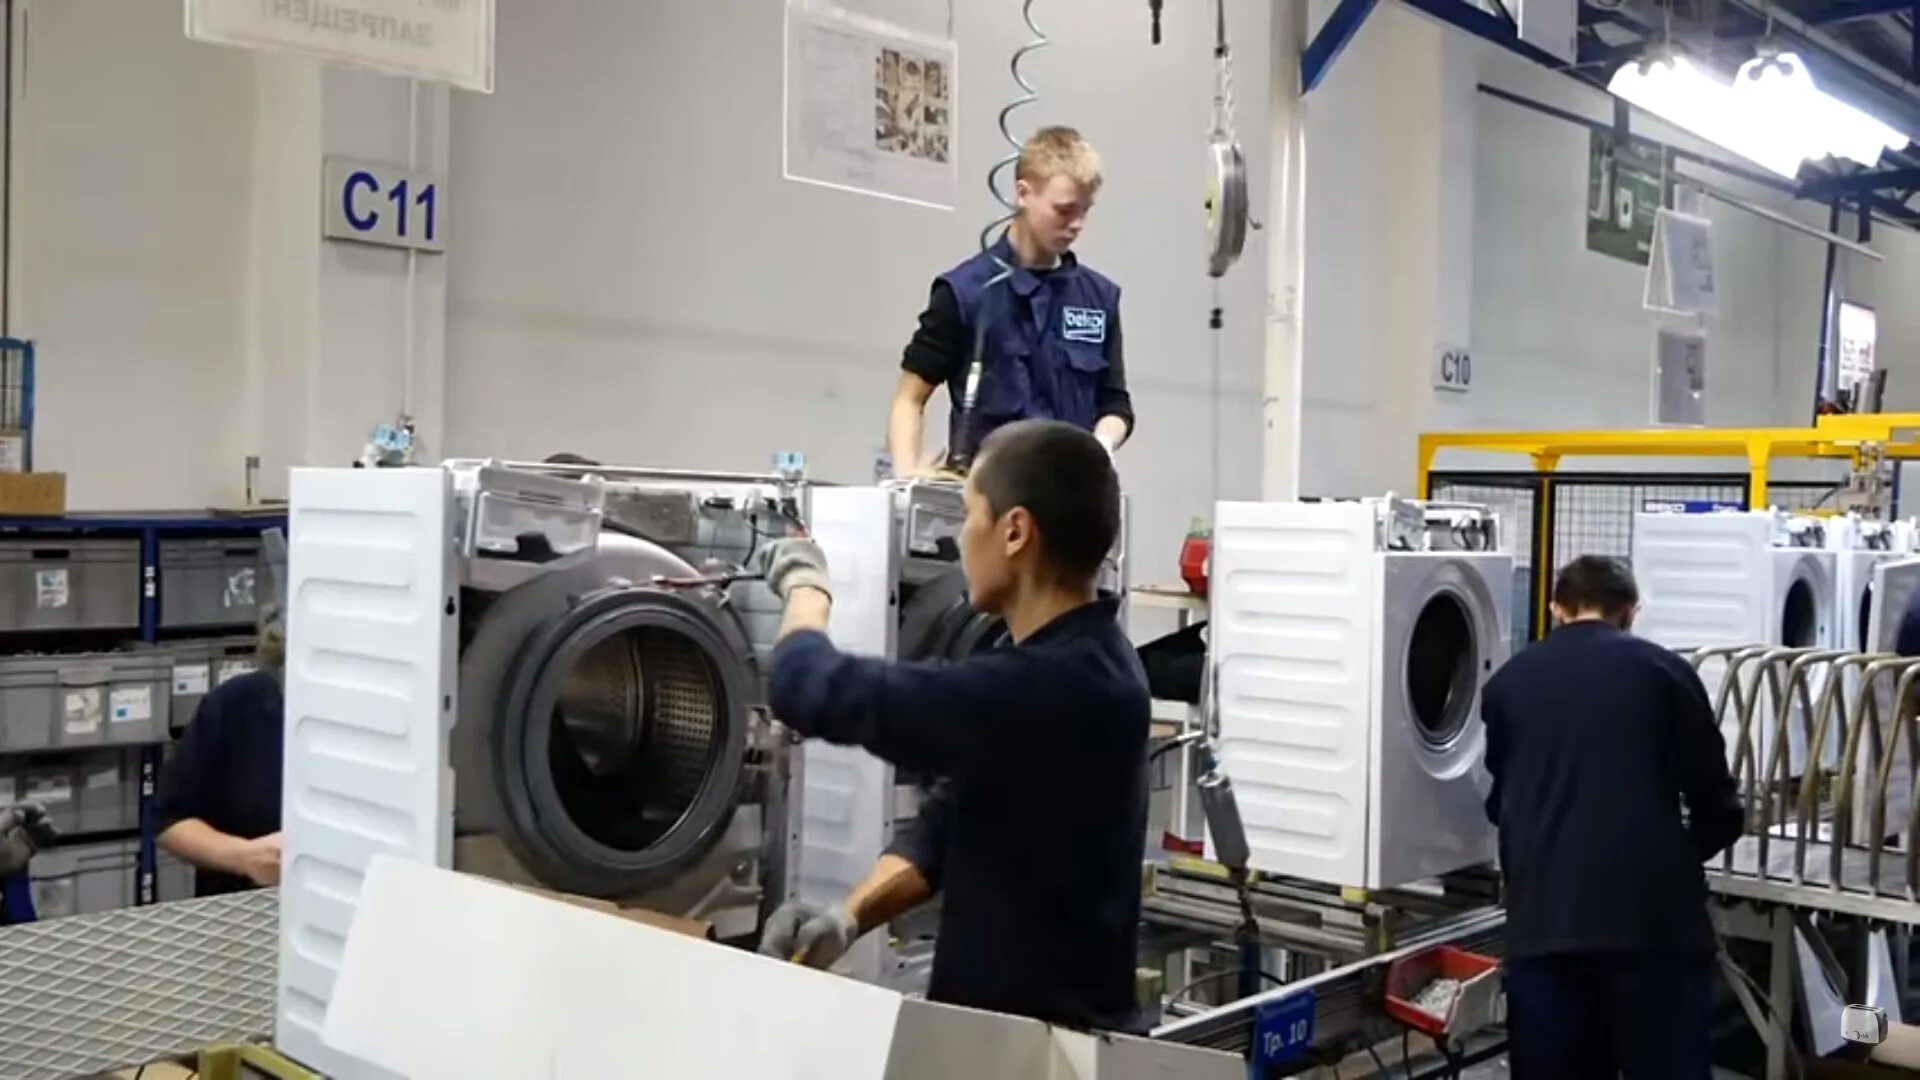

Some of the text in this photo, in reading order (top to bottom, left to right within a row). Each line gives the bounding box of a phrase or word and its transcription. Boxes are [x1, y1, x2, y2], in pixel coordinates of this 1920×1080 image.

[343, 170, 435, 240] C11
[1441, 351, 1471, 385] C10
[1288, 1018, 1307, 1045] 10
